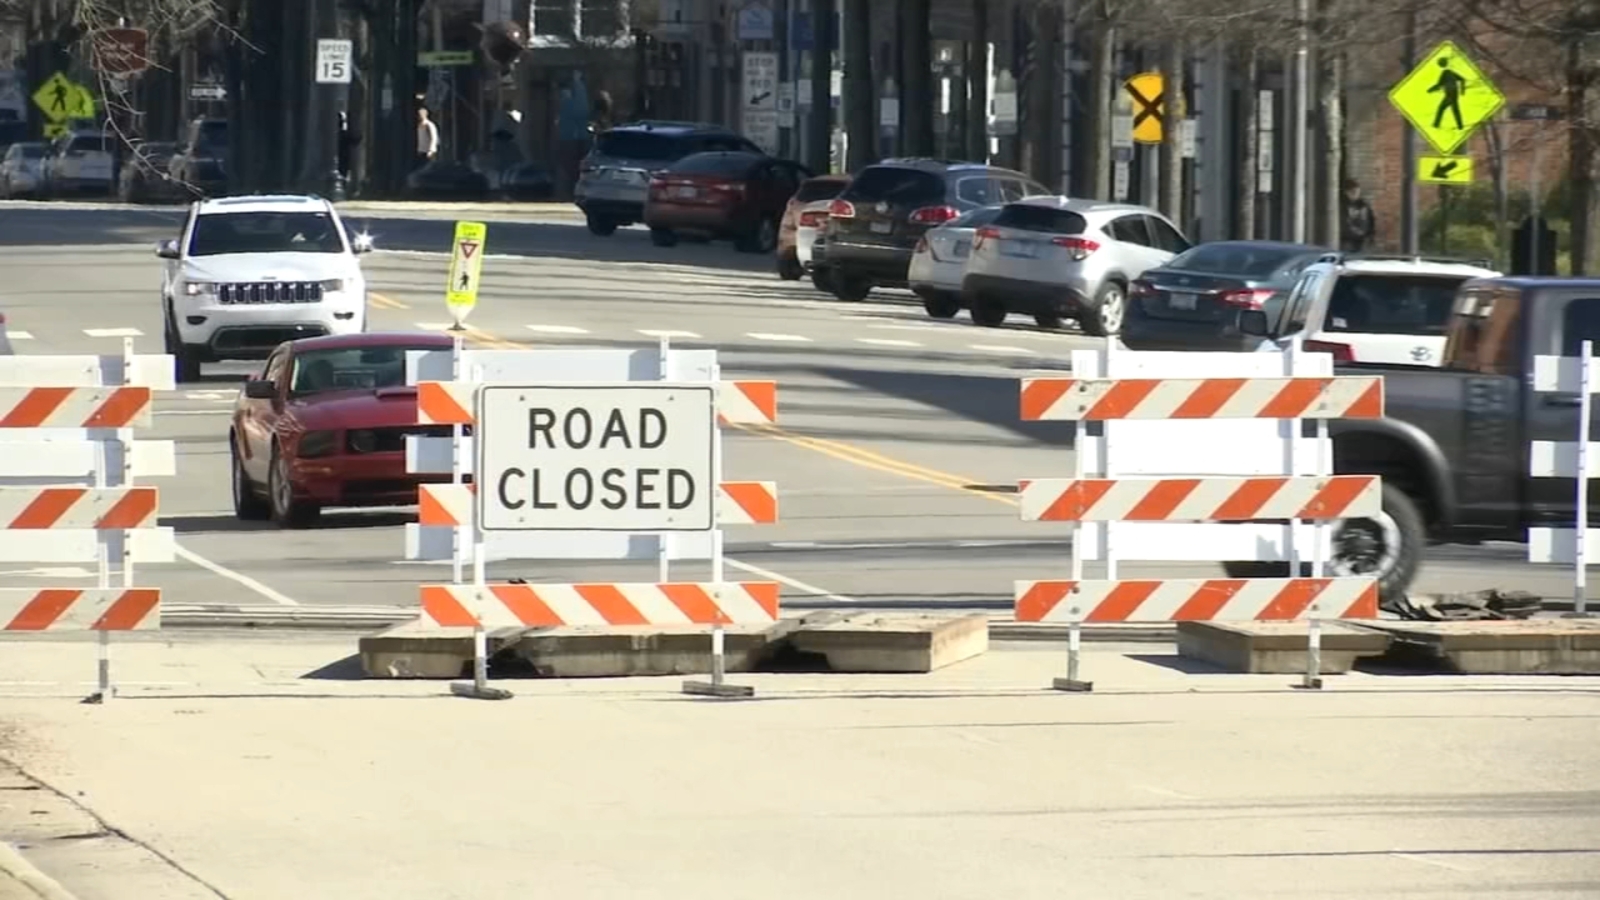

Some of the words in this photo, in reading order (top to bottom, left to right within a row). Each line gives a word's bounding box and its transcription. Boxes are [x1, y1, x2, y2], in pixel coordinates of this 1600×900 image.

[320, 44, 349, 52] SPEED
[323, 62, 344, 79] 15
[528, 407, 668, 449] ROAD
[498, 467, 696, 510] CLOSED
